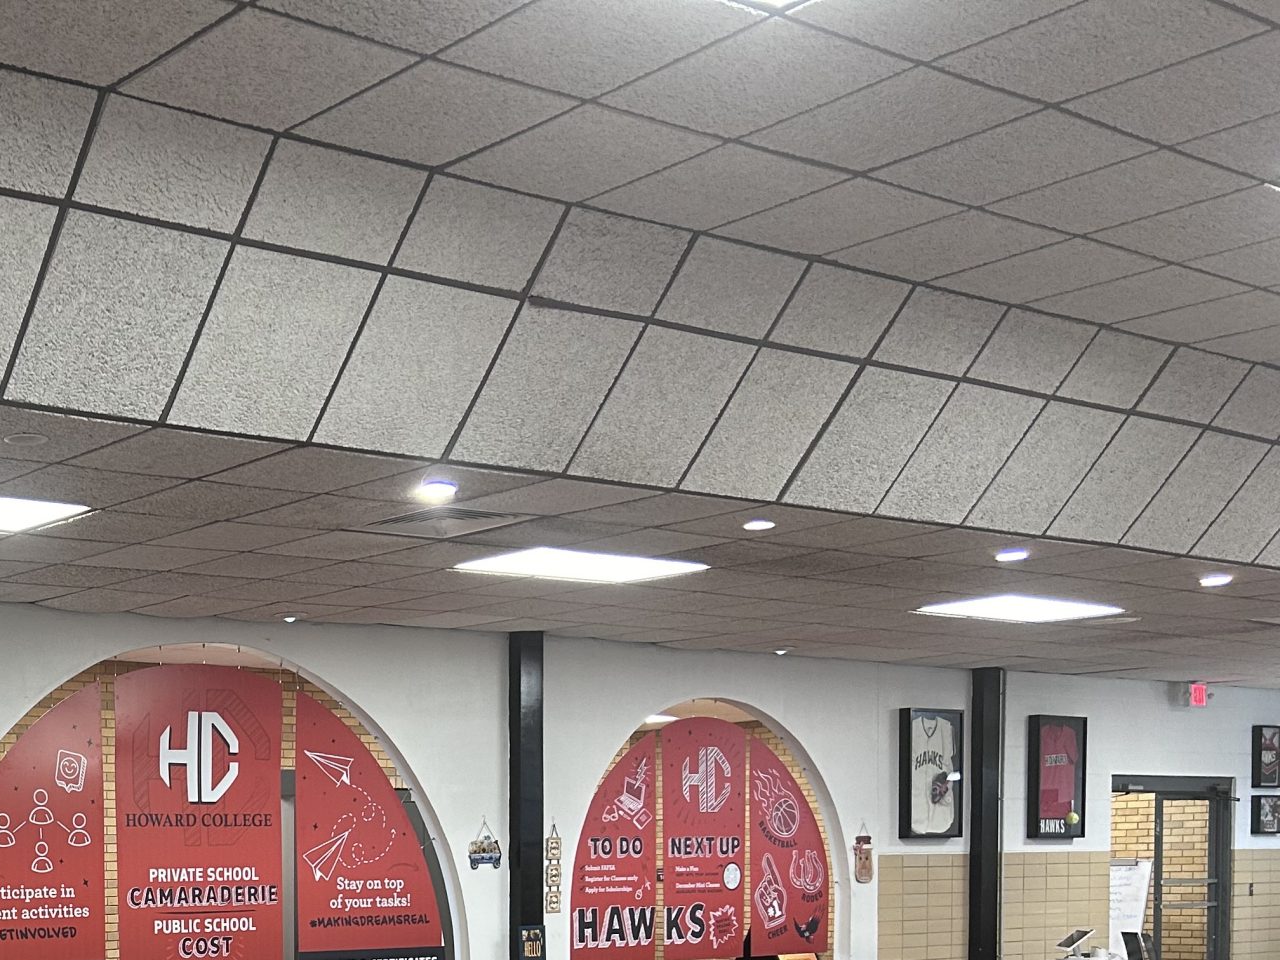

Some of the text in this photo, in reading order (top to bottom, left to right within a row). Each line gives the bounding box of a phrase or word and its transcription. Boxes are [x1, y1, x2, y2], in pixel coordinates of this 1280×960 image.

[915, 751, 943, 770] HAWKS
[125, 813, 273, 828] HOWARD COLLEGE
[1039, 819, 1065, 834] HAWKS
[758, 820, 798, 849] BASKETBALL
[587, 836, 643, 859] TO DO
[668, 836, 741, 859] NEXT UP
[149, 866, 259, 883] PRIVATE SCHOOL
[60, 884, 75, 898] in
[336, 876, 404, 892] Stay on top
[126, 884, 279, 909] CAMARADERIE
[329, 893, 411, 911] of your tasks!
[801, 890, 823, 903] RODEO
[21, 904, 90, 919] activities
[767, 900, 782, 918] #1
[154, 917, 257, 934] PUBLIC SCHOOL
[309, 914, 430, 929] #MAKINGDREAMSREAL
[572, 902, 706, 949] HAWKS
[767, 924, 788, 940] CHEER
[178, 935, 234, 959] COST
[524, 940, 541, 958] HELLO
